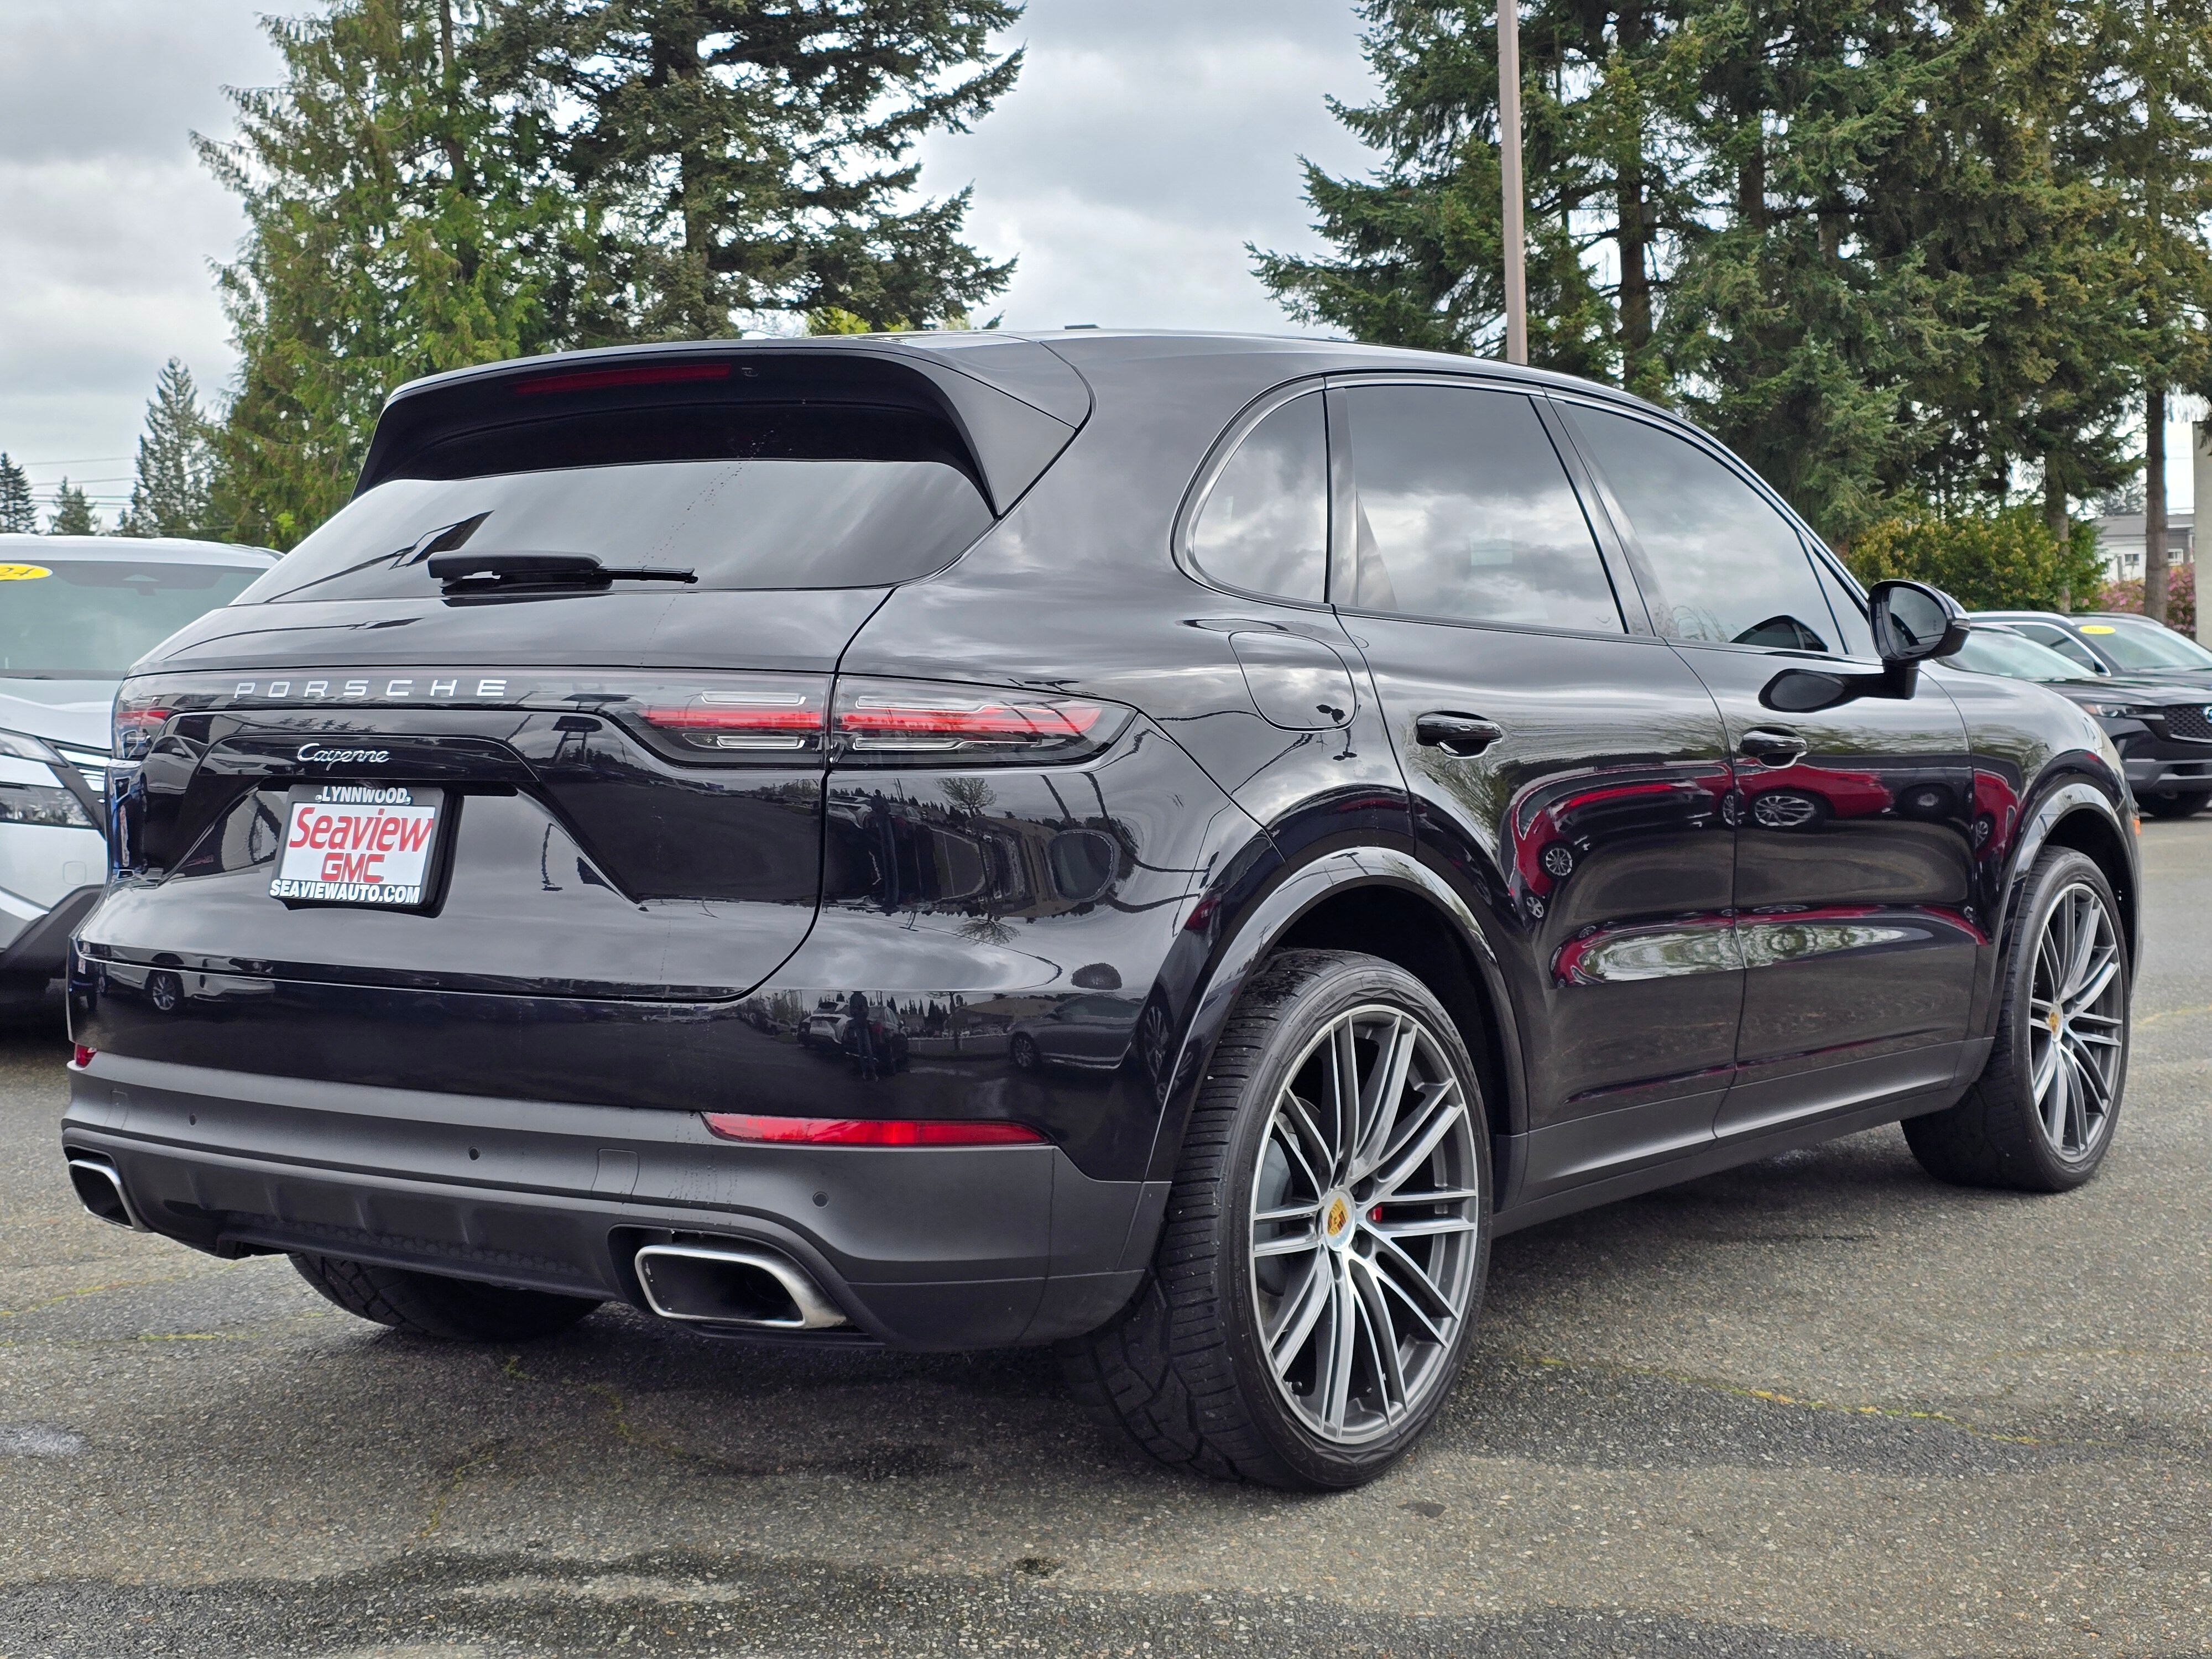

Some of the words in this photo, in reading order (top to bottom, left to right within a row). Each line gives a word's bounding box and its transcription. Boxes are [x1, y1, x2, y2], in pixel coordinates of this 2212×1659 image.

[233, 679, 508, 698] PORSCHE
[297, 743, 390, 771] Cayenne
[321, 786, 408, 804] LYNNWOOD
[289, 807, 434, 852] Seaview
[321, 852, 385, 884] GMC
[269, 880, 420, 904] SEAVIEWAUTO.COM
